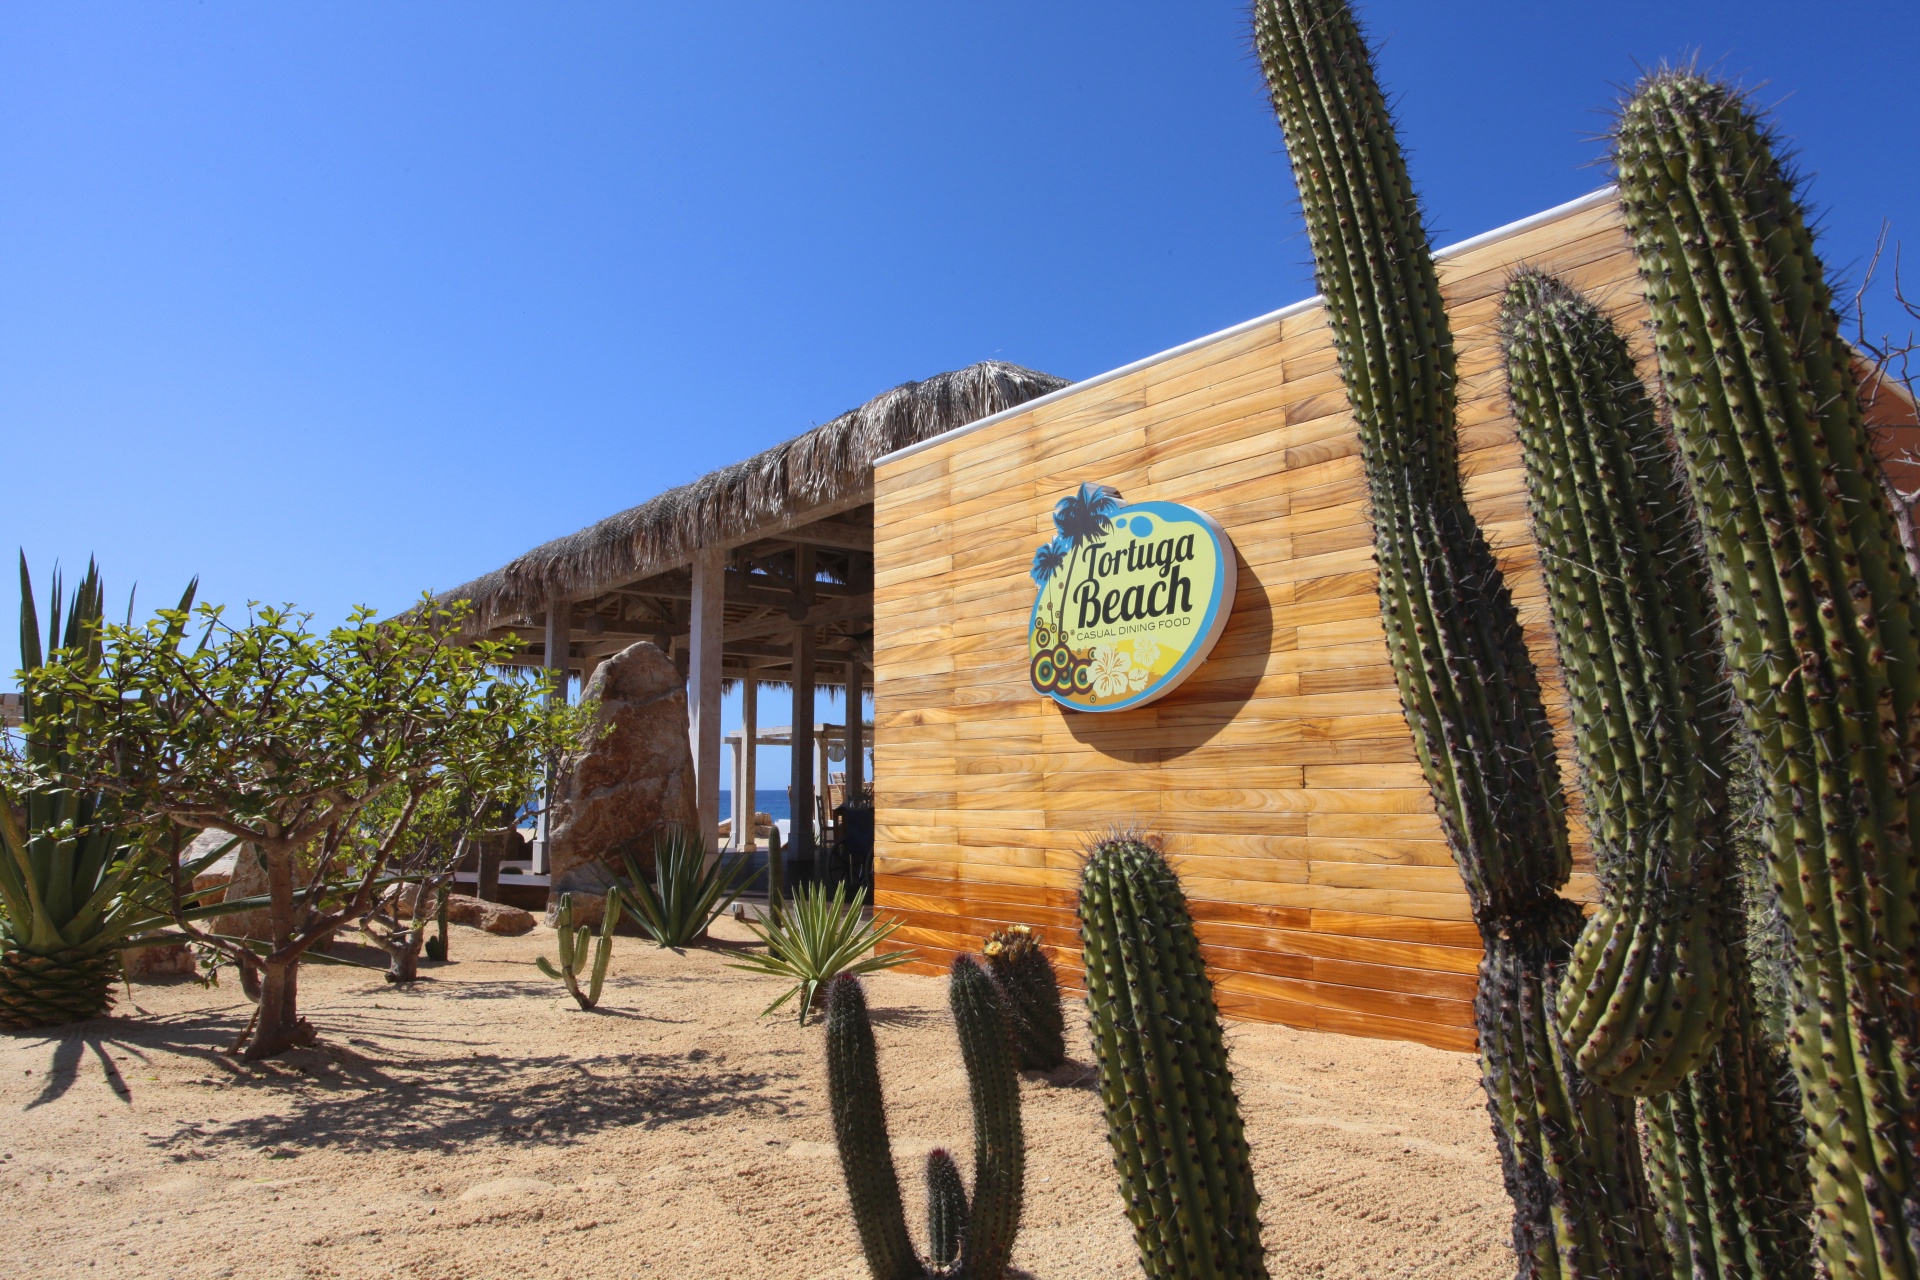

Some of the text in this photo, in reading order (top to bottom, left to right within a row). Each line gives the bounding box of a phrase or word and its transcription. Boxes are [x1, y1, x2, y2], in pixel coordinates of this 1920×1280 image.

[1082, 533, 1195, 579] Tortuga
[1073, 564, 1193, 629] Beach
[1076, 616, 1191, 641] CASUAL DINING FOOD
